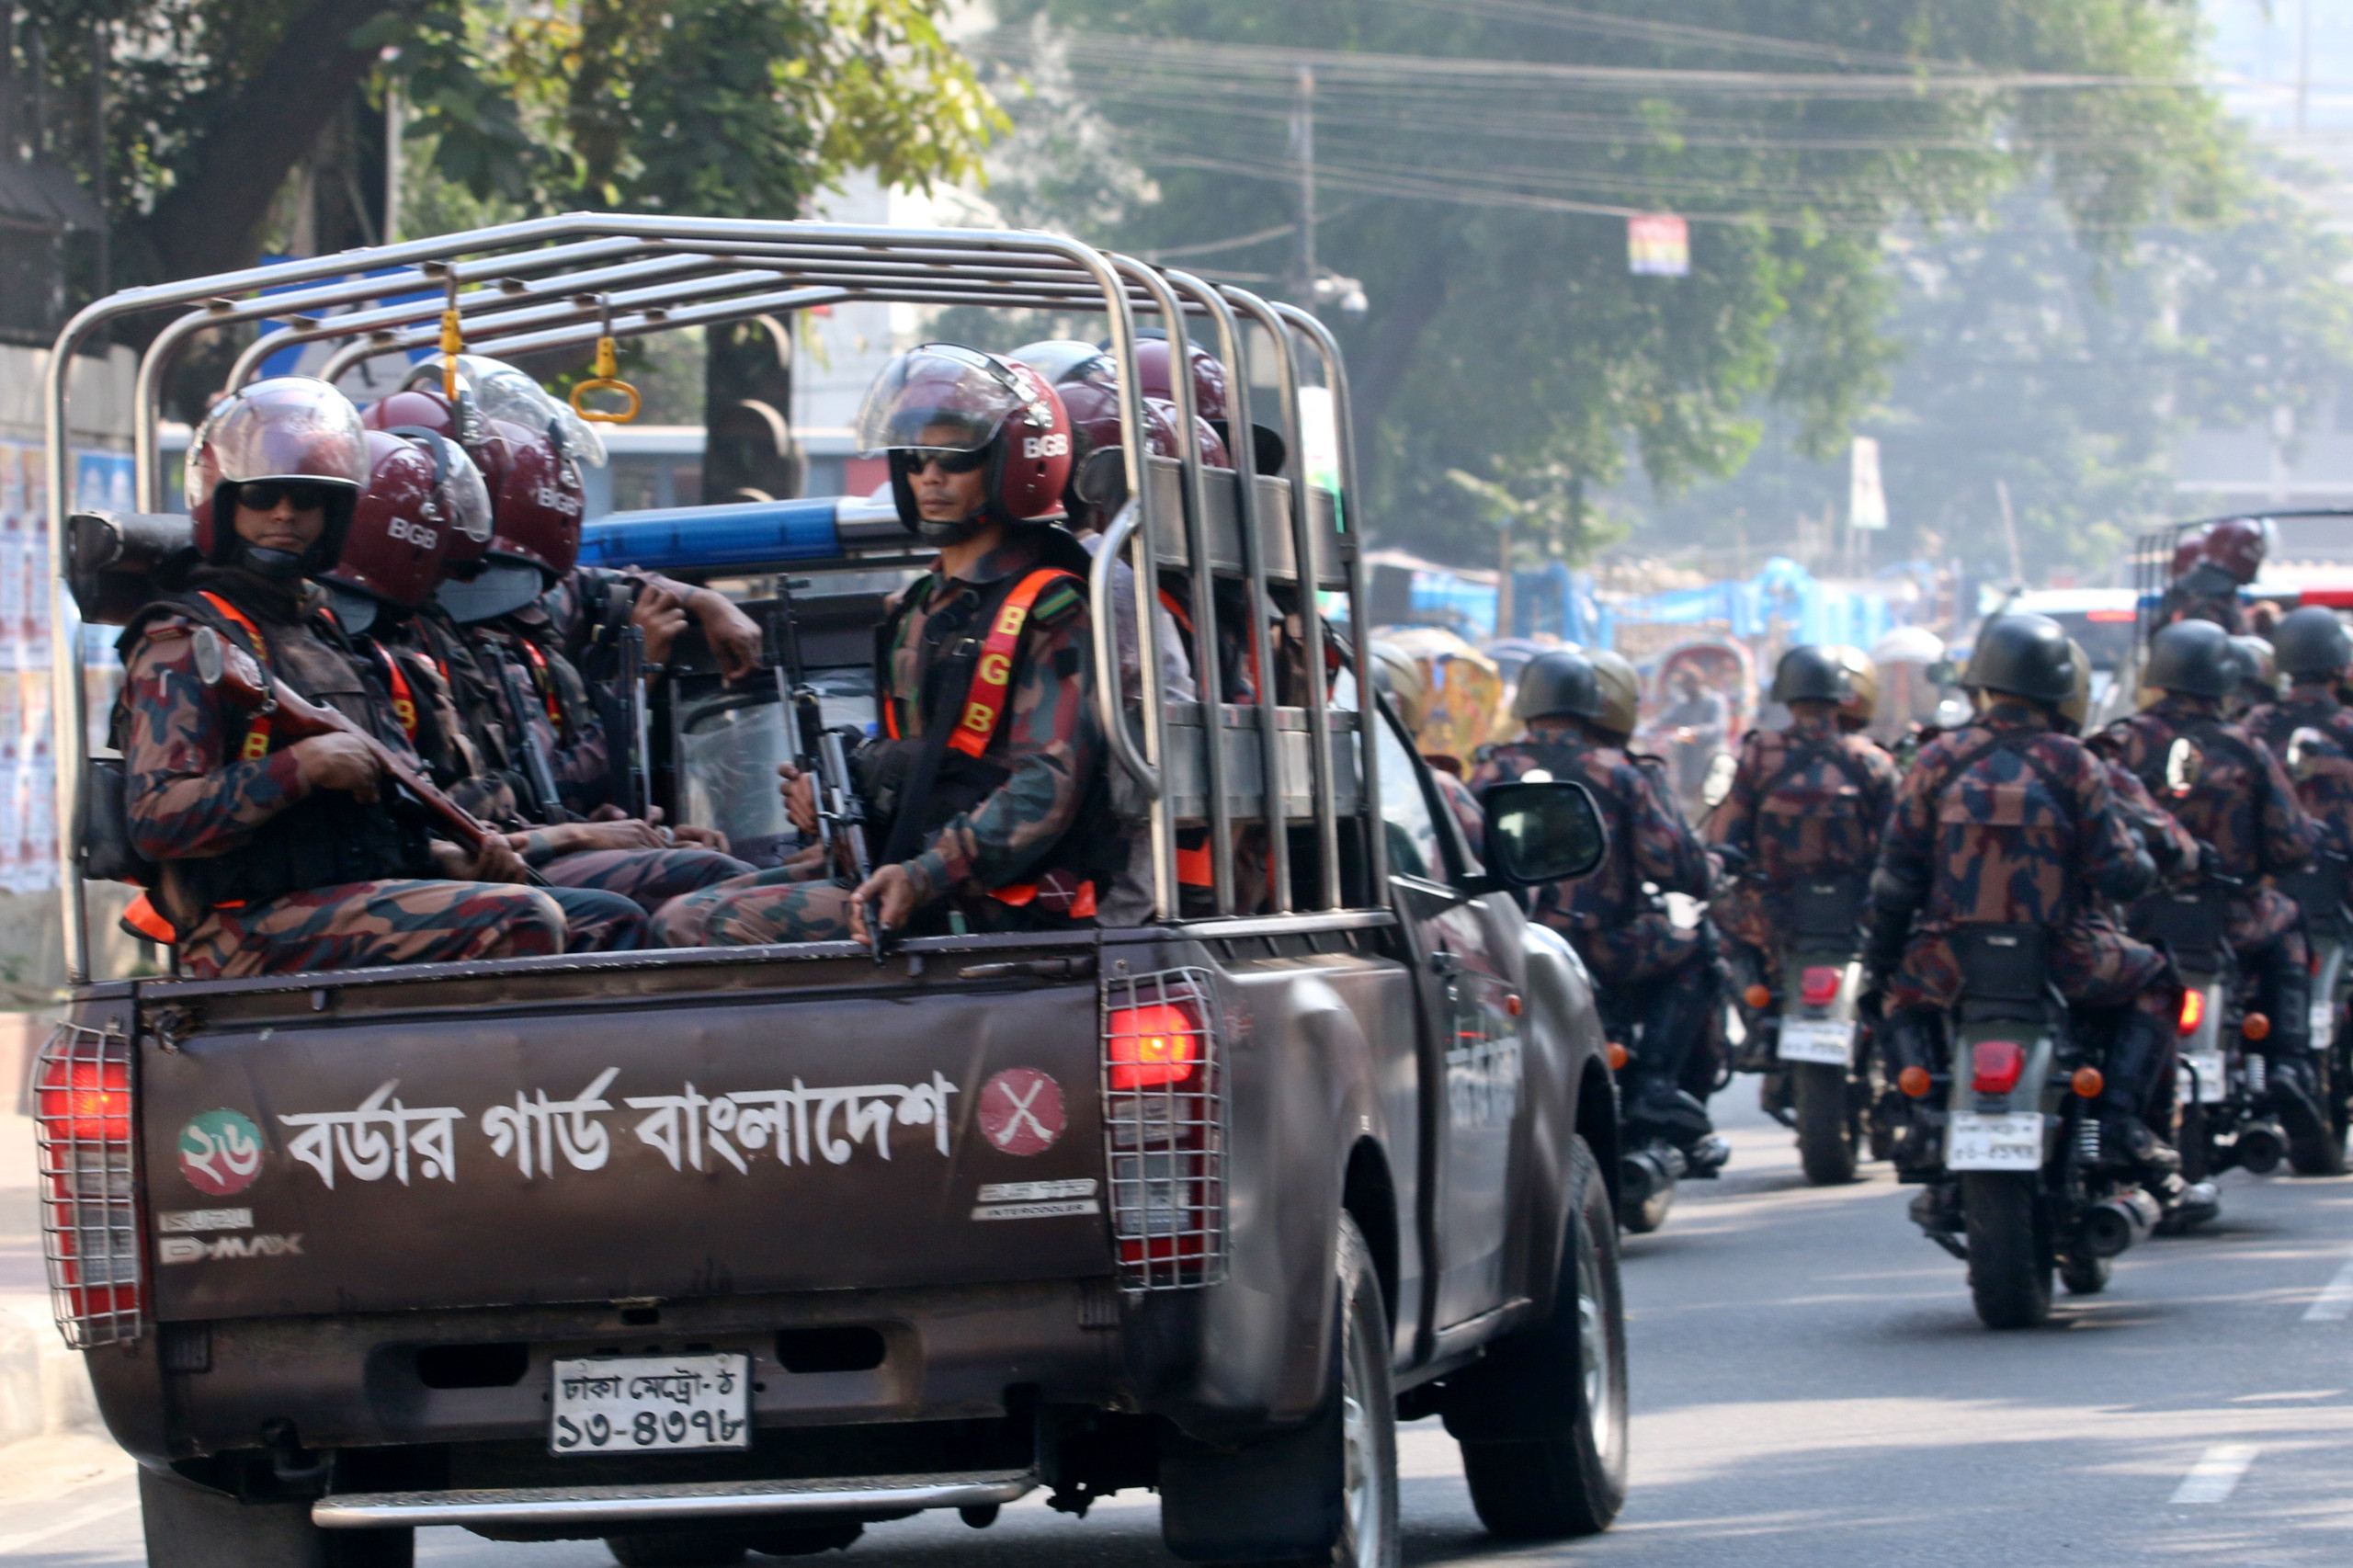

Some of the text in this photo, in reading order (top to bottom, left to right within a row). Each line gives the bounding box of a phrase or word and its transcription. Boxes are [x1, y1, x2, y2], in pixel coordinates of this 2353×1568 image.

[1023, 433, 1069, 460] BGB
[538, 487, 578, 517] BGB
[387, 517, 438, 550] BGB
[277, 1067, 960, 1190] বর্ডার গার্ড বাংলাদেশ
[183, 1123, 260, 1187] ২৬
[159, 1208, 254, 1233] ISUZU
[985, 1203, 1086, 1218] INTERCOOLER
[159, 1233, 305, 1265] D-MAX
[562, 1376, 622, 1400] ঢাকা
